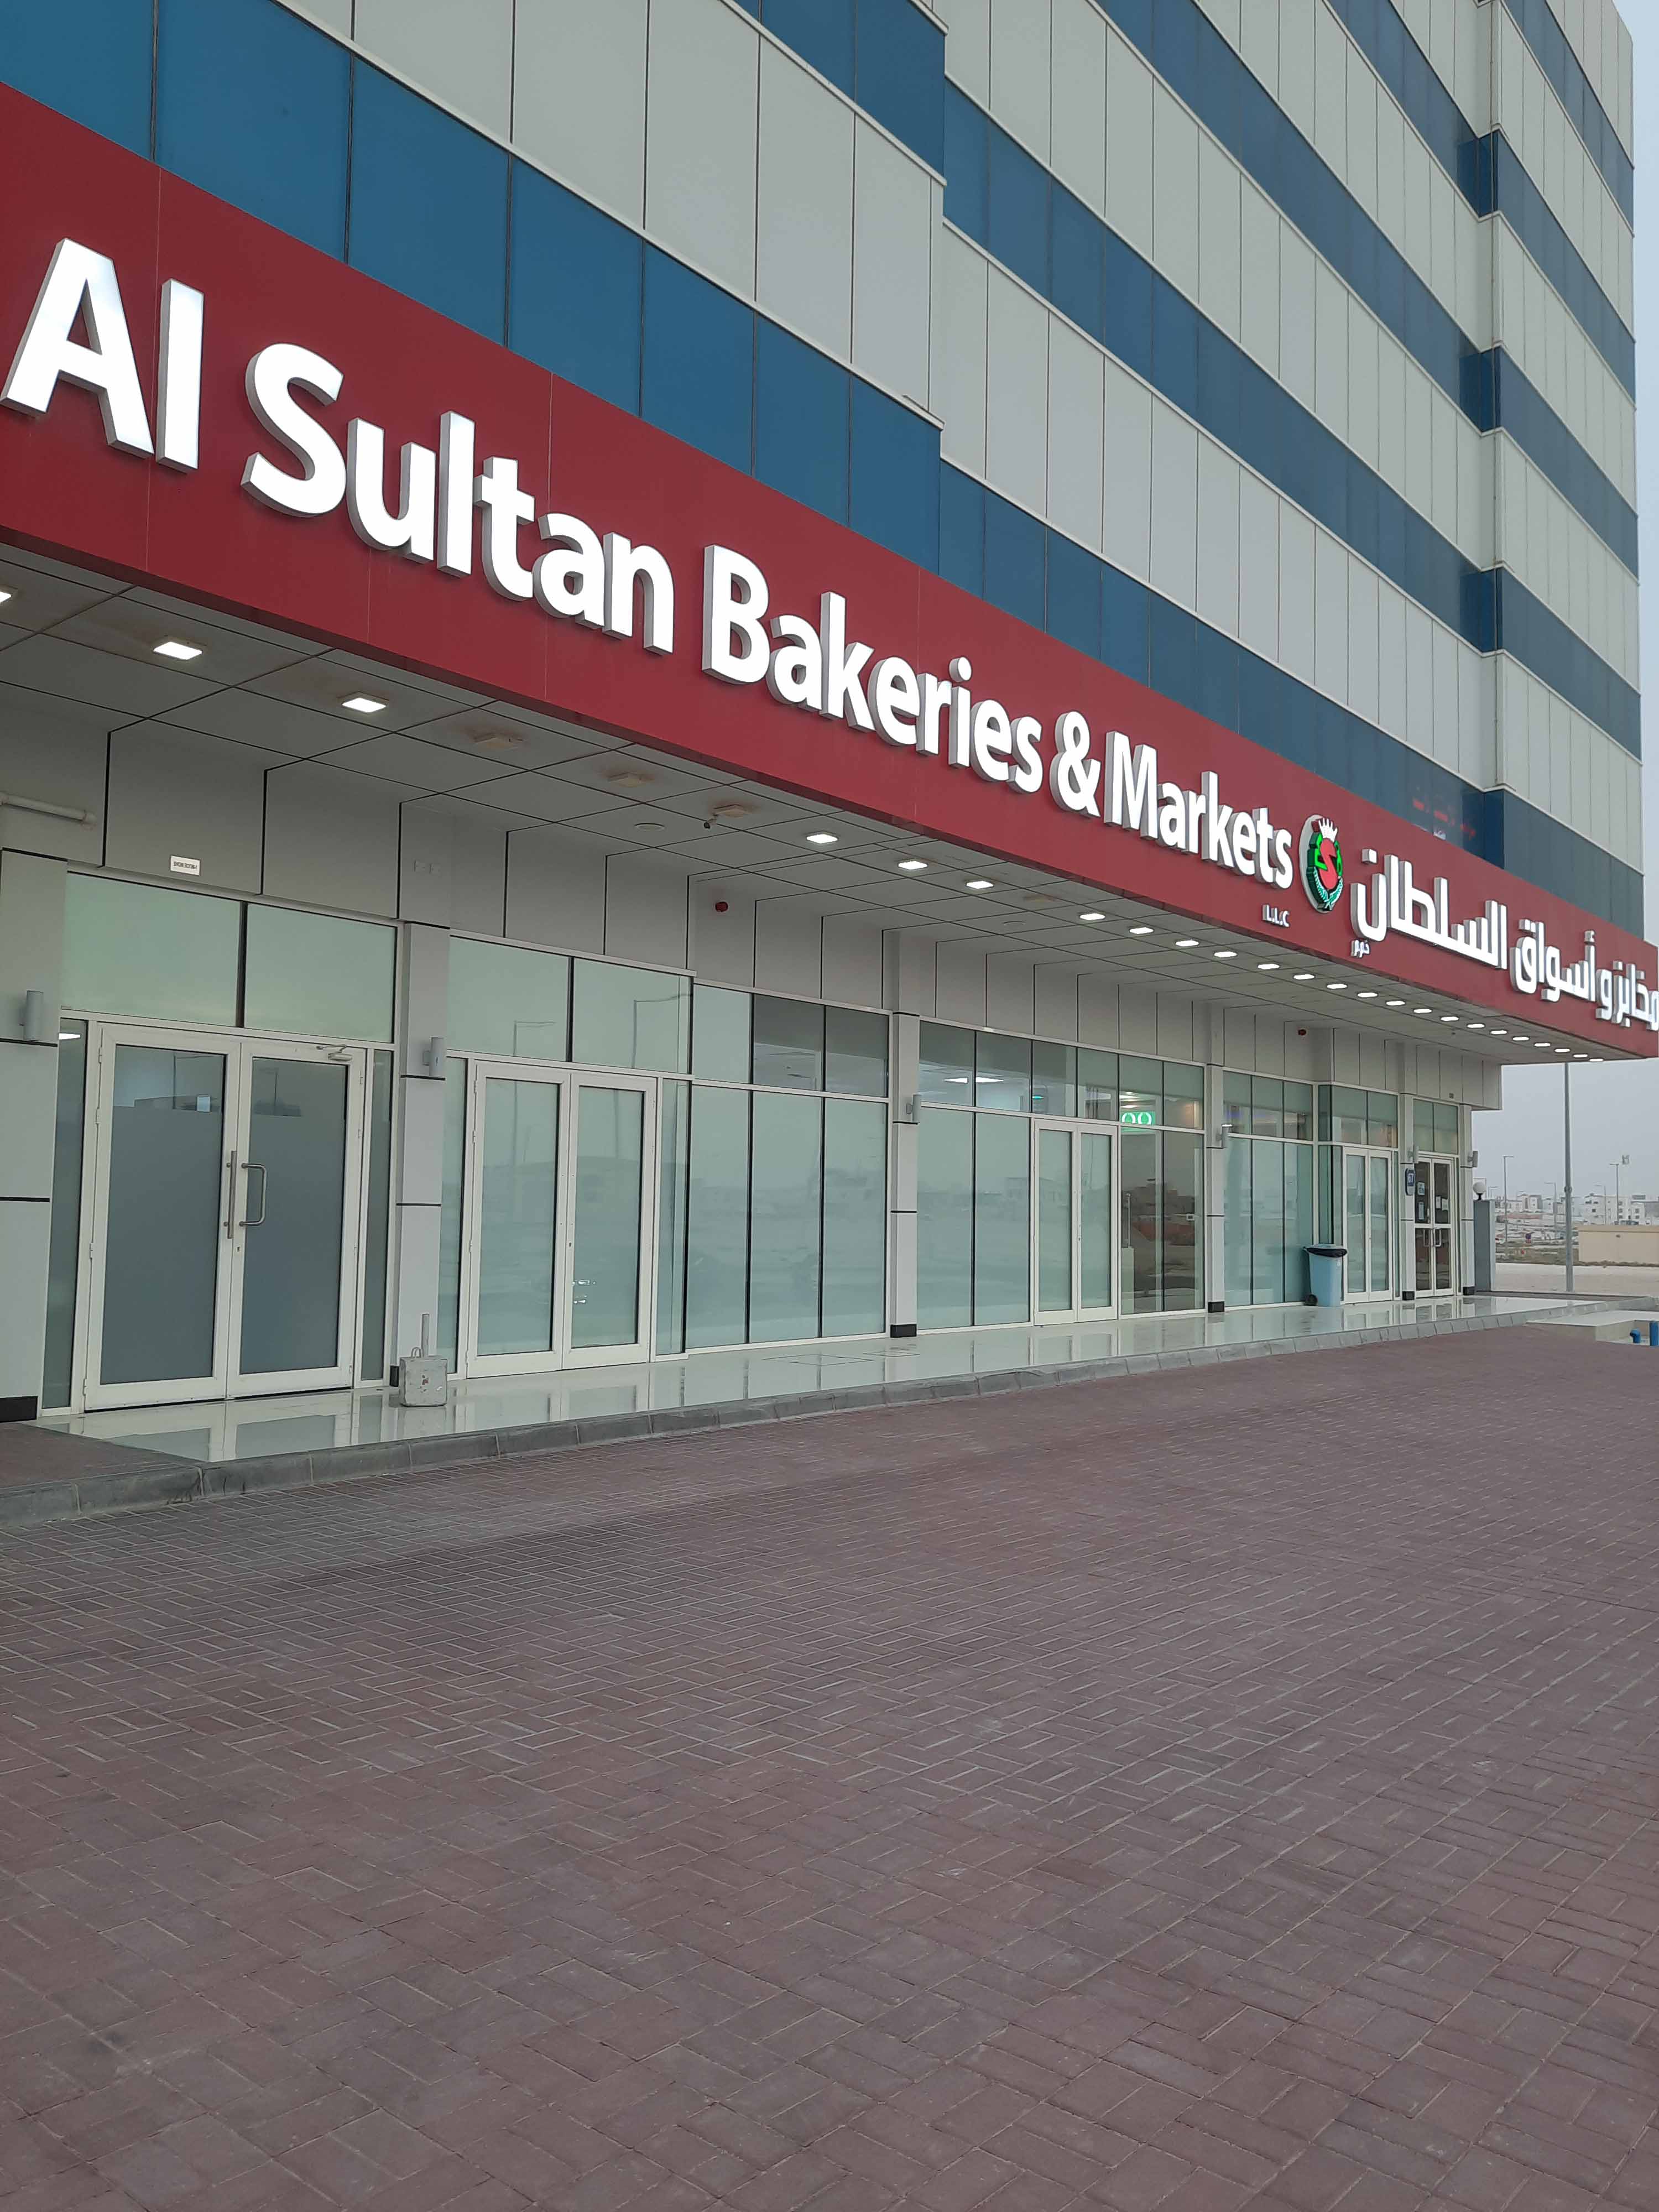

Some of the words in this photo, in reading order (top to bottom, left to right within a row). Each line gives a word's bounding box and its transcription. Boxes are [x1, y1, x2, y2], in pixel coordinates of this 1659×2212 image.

[1, 238, 204, 473] Al
[241, 343, 674, 656] Sultan
[702, 544, 1043, 794] Bakeries
[1050, 711, 1101, 817] &
[1104, 731, 1293, 889] Markets
[1350, 848, 1507, 969] السلطان
